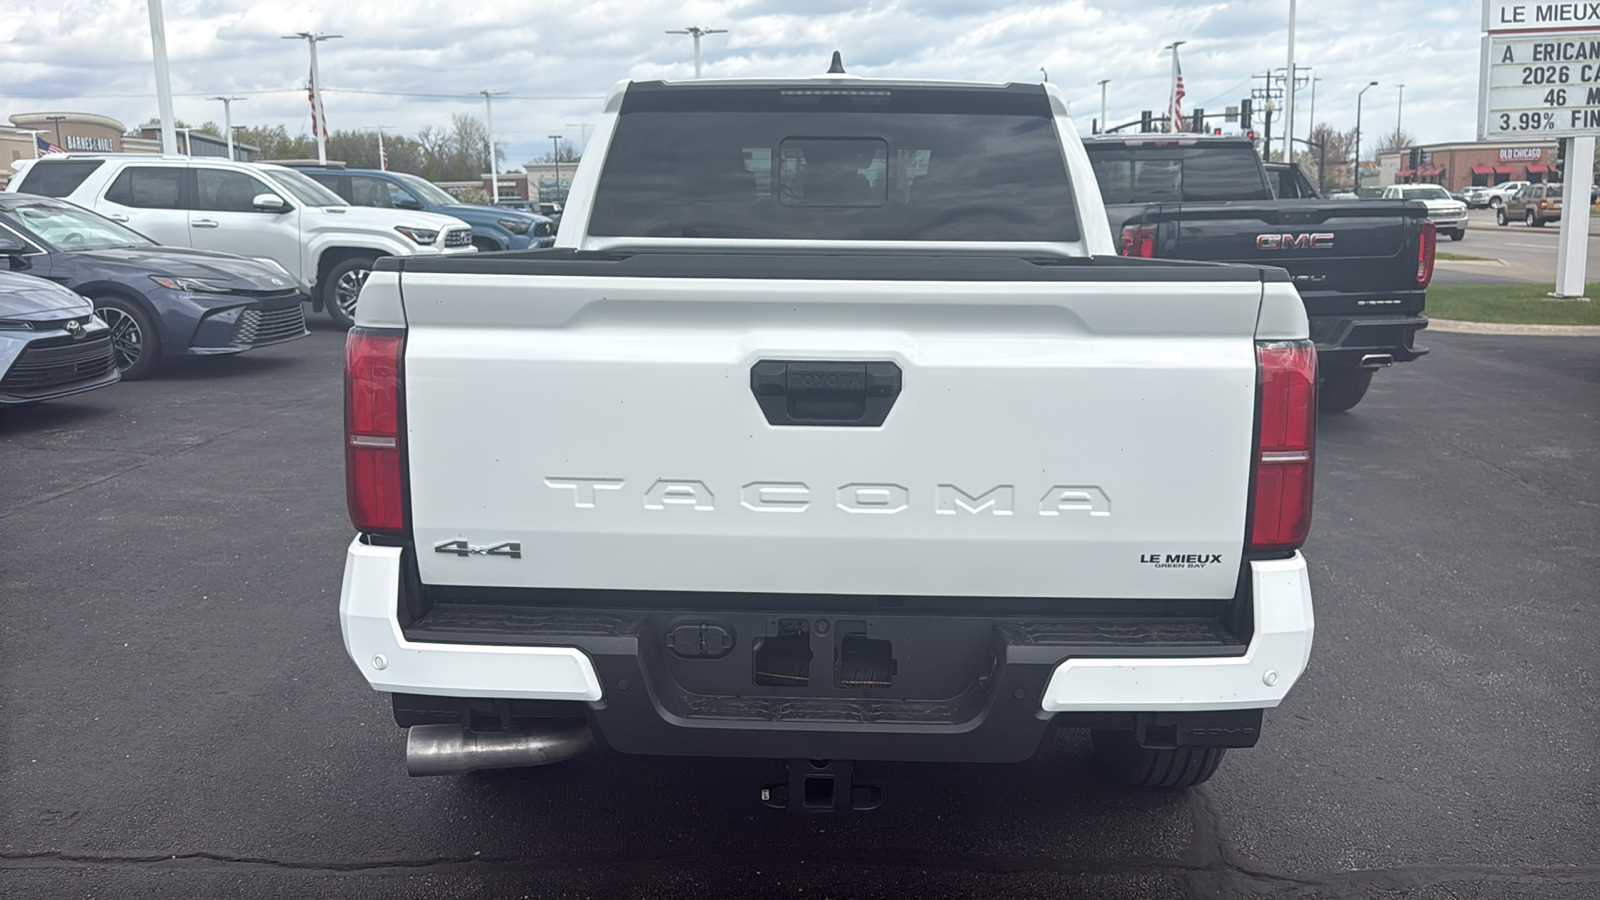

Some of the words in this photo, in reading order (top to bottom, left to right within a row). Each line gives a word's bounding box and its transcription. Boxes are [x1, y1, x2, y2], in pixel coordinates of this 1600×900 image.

[1501, 6, 1526, 23] LE
[1536, 3, 1600, 22] MIEUX
[1522, 66, 1570, 84] 2026
[1543, 88, 1567, 106] 46
[1500, 112, 1554, 131] 3.99%
[1571, 110, 1600, 128] FIN
[67, 135, 93, 150] BARNES
[1256, 233, 1334, 250] GMC
[791, 372, 862, 388] TOYOTA
[544, 476, 1111, 517] TACOMA
[1140, 554, 1161, 564] LE
[1165, 554, 1222, 564] MIEUX
